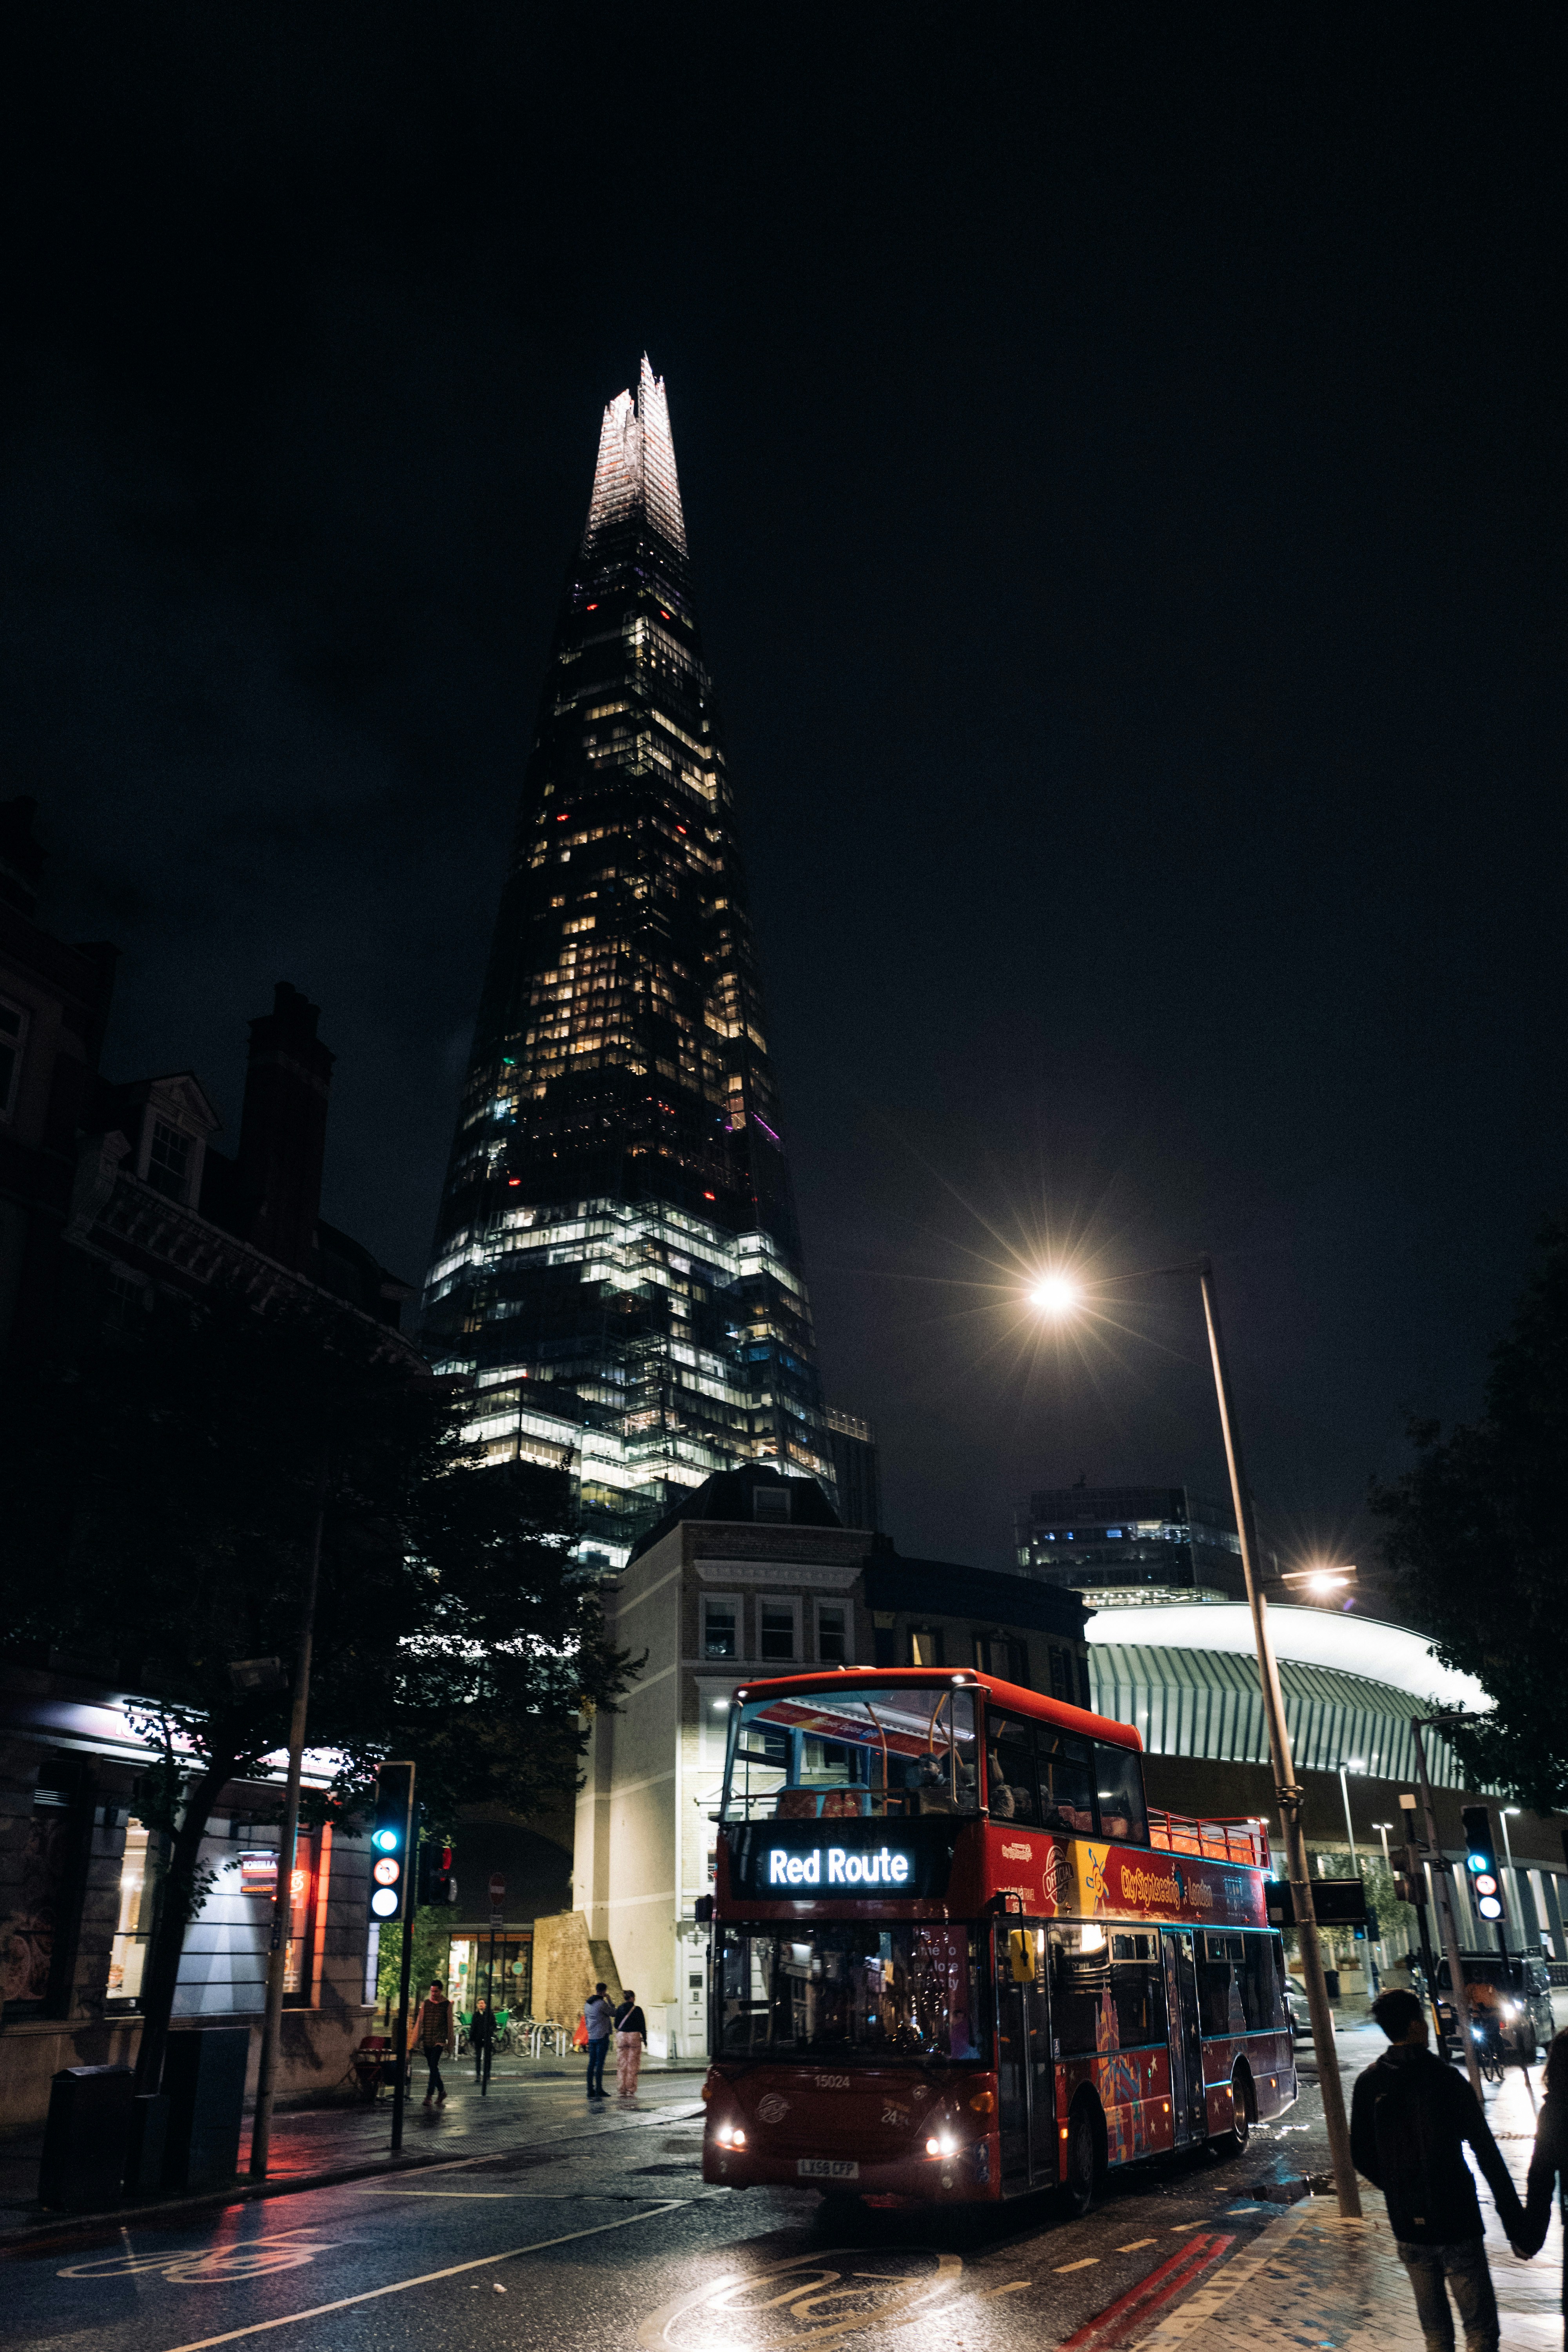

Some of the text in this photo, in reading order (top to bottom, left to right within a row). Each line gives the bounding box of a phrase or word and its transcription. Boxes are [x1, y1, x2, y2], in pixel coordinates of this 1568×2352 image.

[243, 1860, 277, 1870] TORTILLA
[770, 1847, 908, 1883] Red Route
[1046, 1864, 1073, 1893] OFFICIAL
[1121, 1865, 1180, 1911] CitySightseeing
[1188, 1876, 1213, 1908] London
[914, 1960, 958, 1974] exloe
[814, 2075, 851, 2088] 15024
